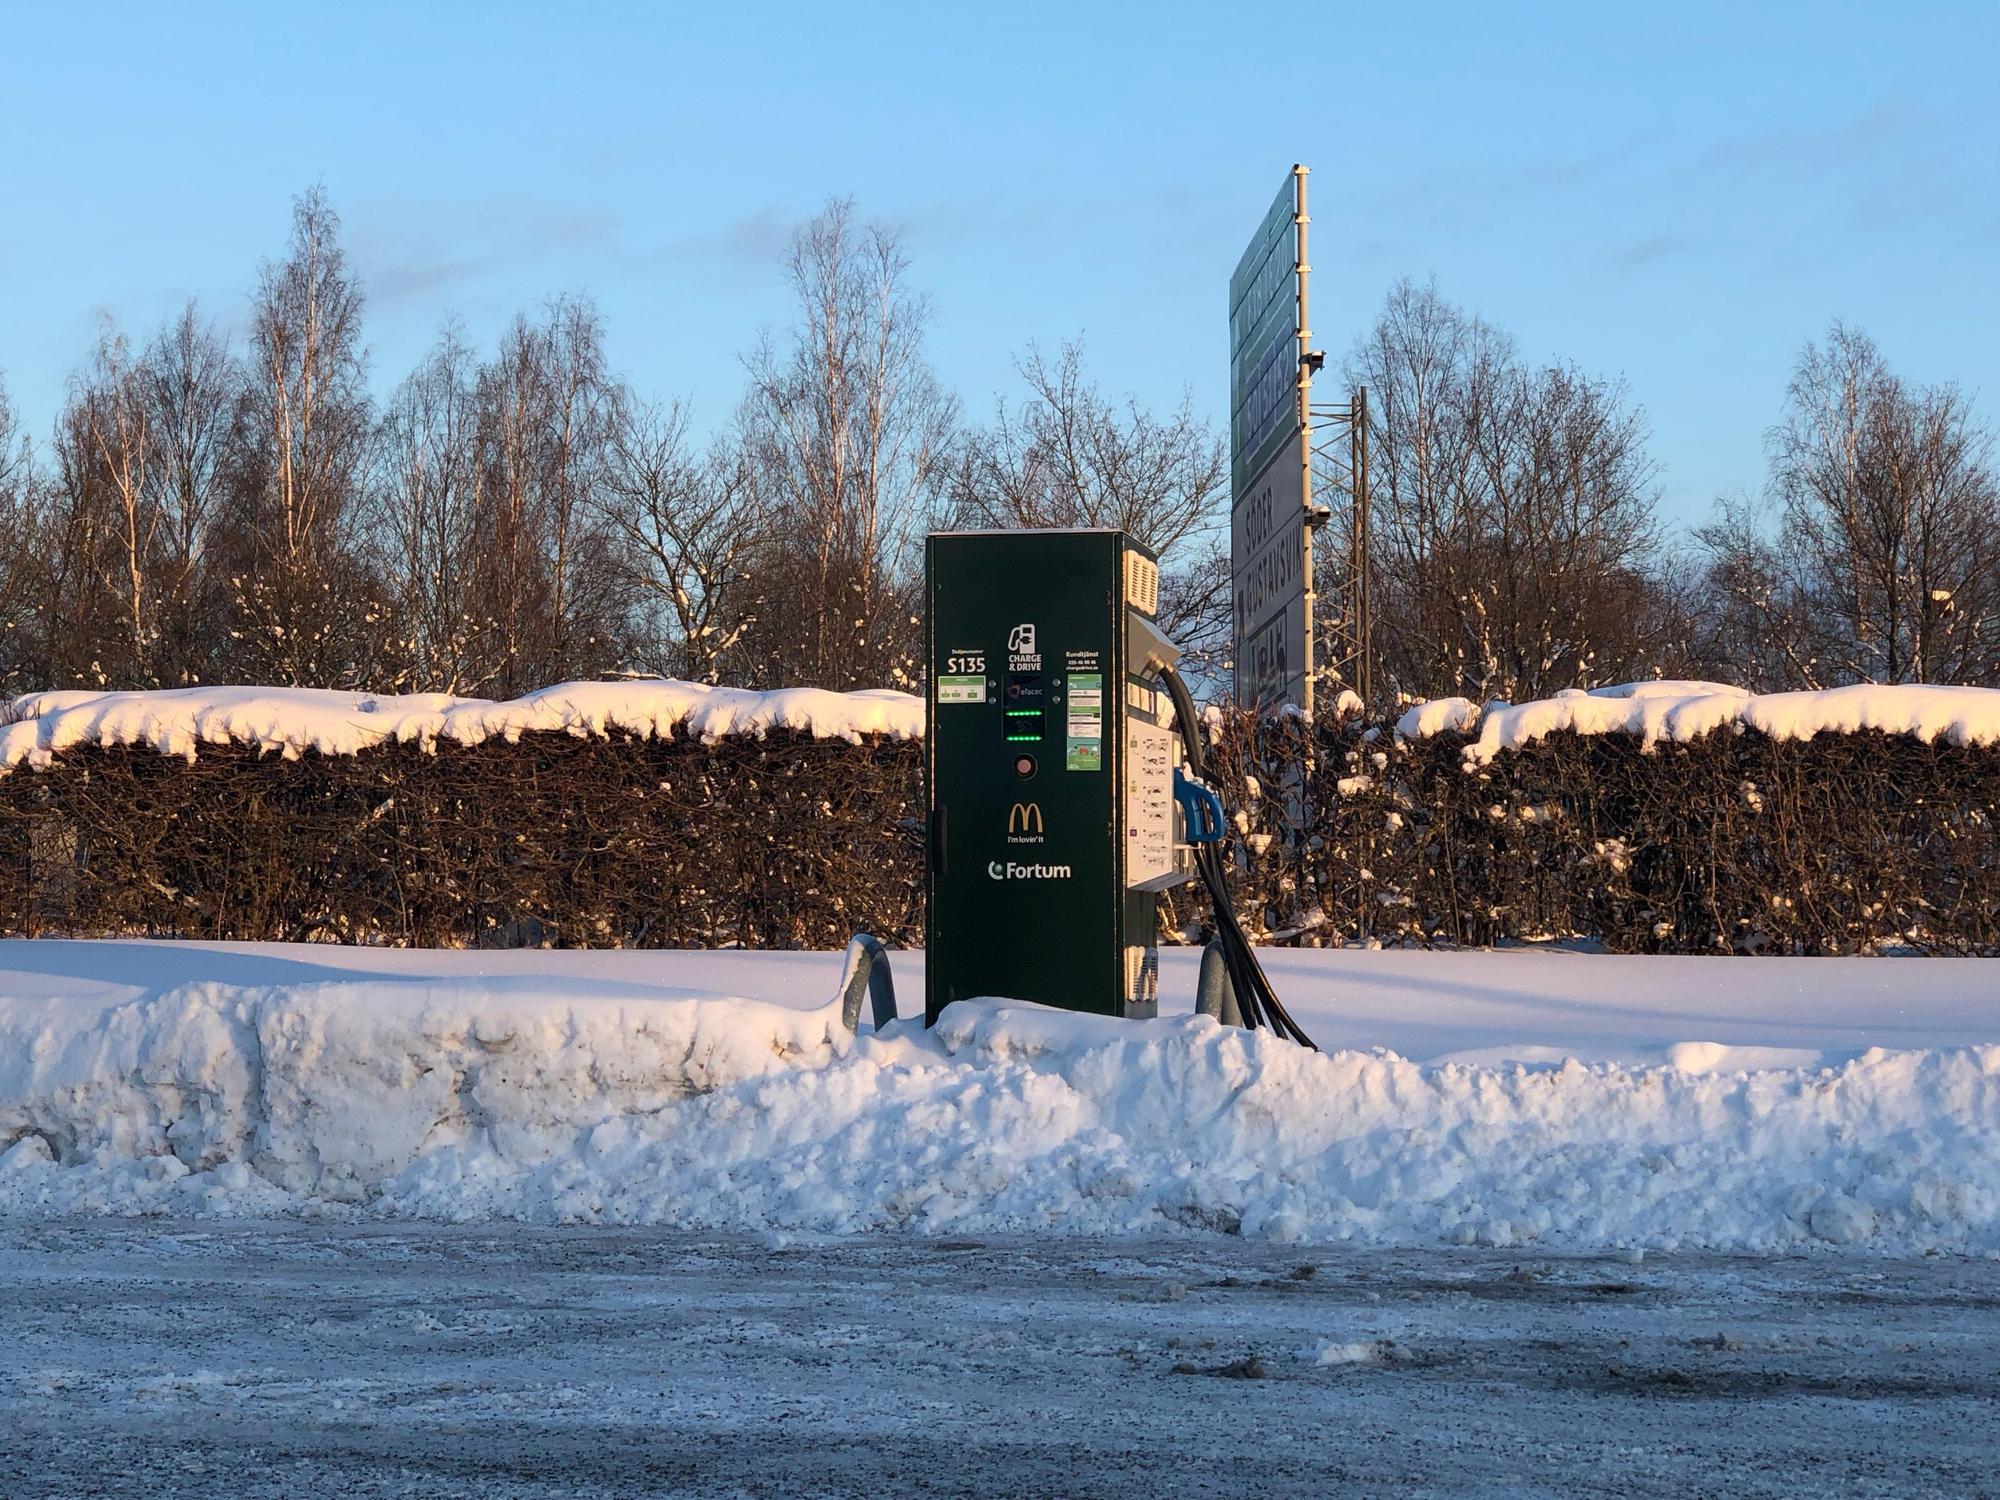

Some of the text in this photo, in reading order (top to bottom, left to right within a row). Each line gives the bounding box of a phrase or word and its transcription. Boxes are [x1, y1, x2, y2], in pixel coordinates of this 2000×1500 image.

[1248, 231, 1288, 331] E18 E20
[1246, 485, 1273, 555] SÖDER
[1247, 521, 1302, 617] GUSTAVSVIK
[947, 657, 986, 673] S135
[1008, 654, 1042, 663] CHARGE
[1008, 662, 1042, 671] & DRIVE
[1020, 688, 1043, 696] efacec
[1006, 861, 1072, 879] Fortum
